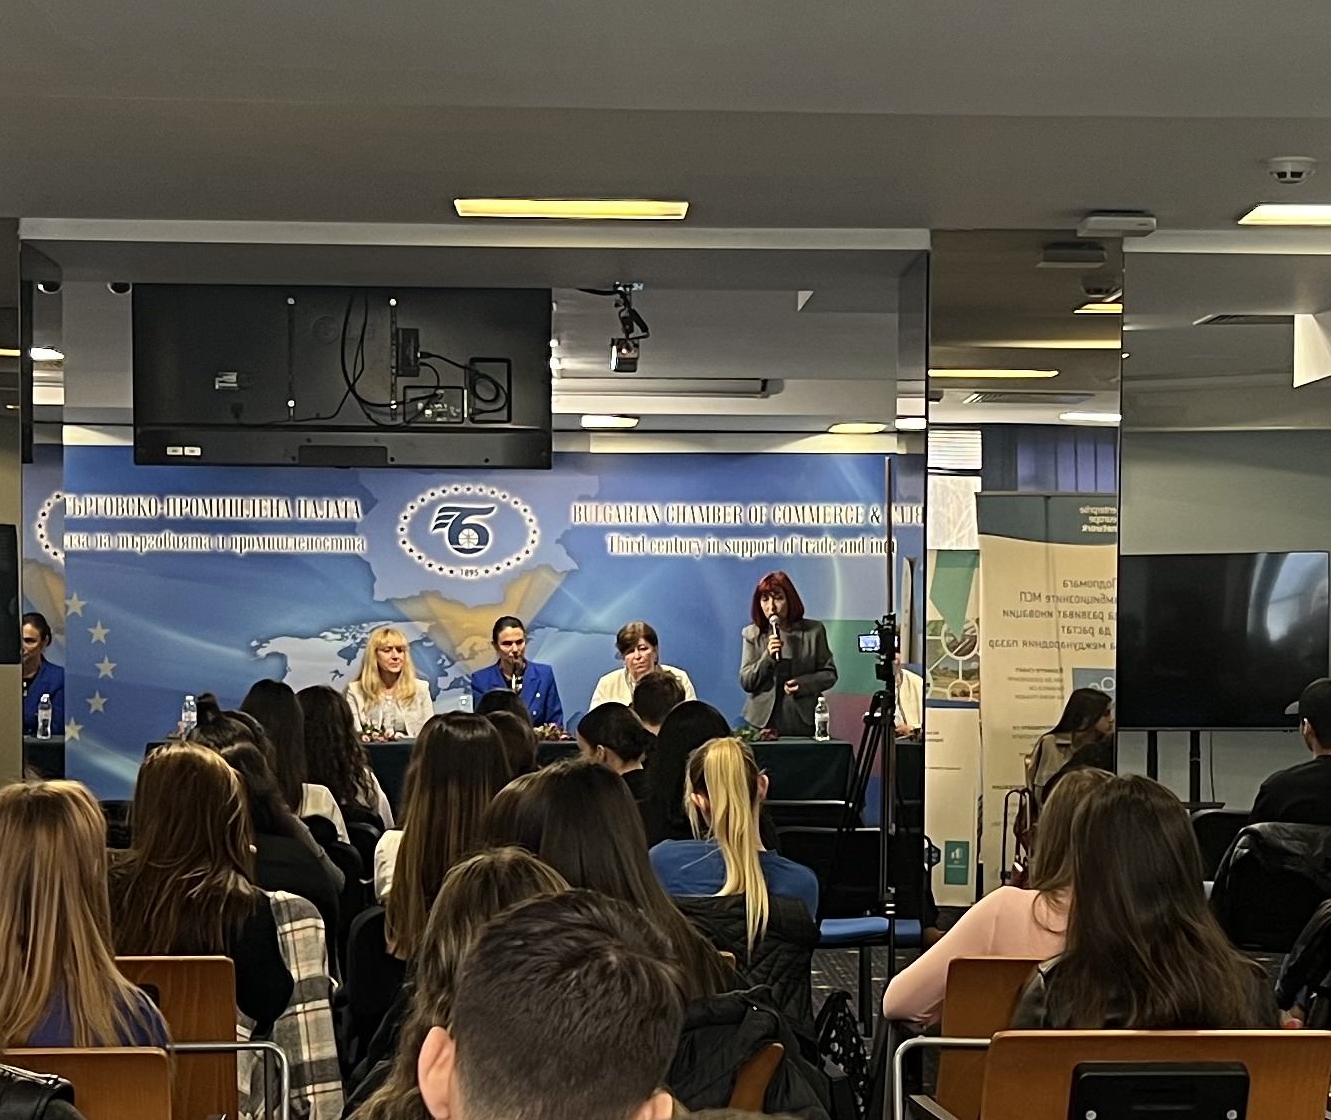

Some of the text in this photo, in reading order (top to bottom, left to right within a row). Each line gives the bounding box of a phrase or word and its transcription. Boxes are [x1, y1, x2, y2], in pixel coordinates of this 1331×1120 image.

[297, 499, 361, 519] ПАЛАТА
[573, 504, 882, 524] BULGARIAN CHAMBER OF COMMERCE &
[230, 535, 366, 555] промишлеността
[609, 534, 645, 554] Third
[650, 535, 701, 559] century
[707, 535, 720, 554] in
[724, 536, 776, 558] support
[782, 536, 797, 554] of
[800, 536, 837, 554] trade
[840, 536, 865, 554] and
[460, 567, 479, 578] 1895
